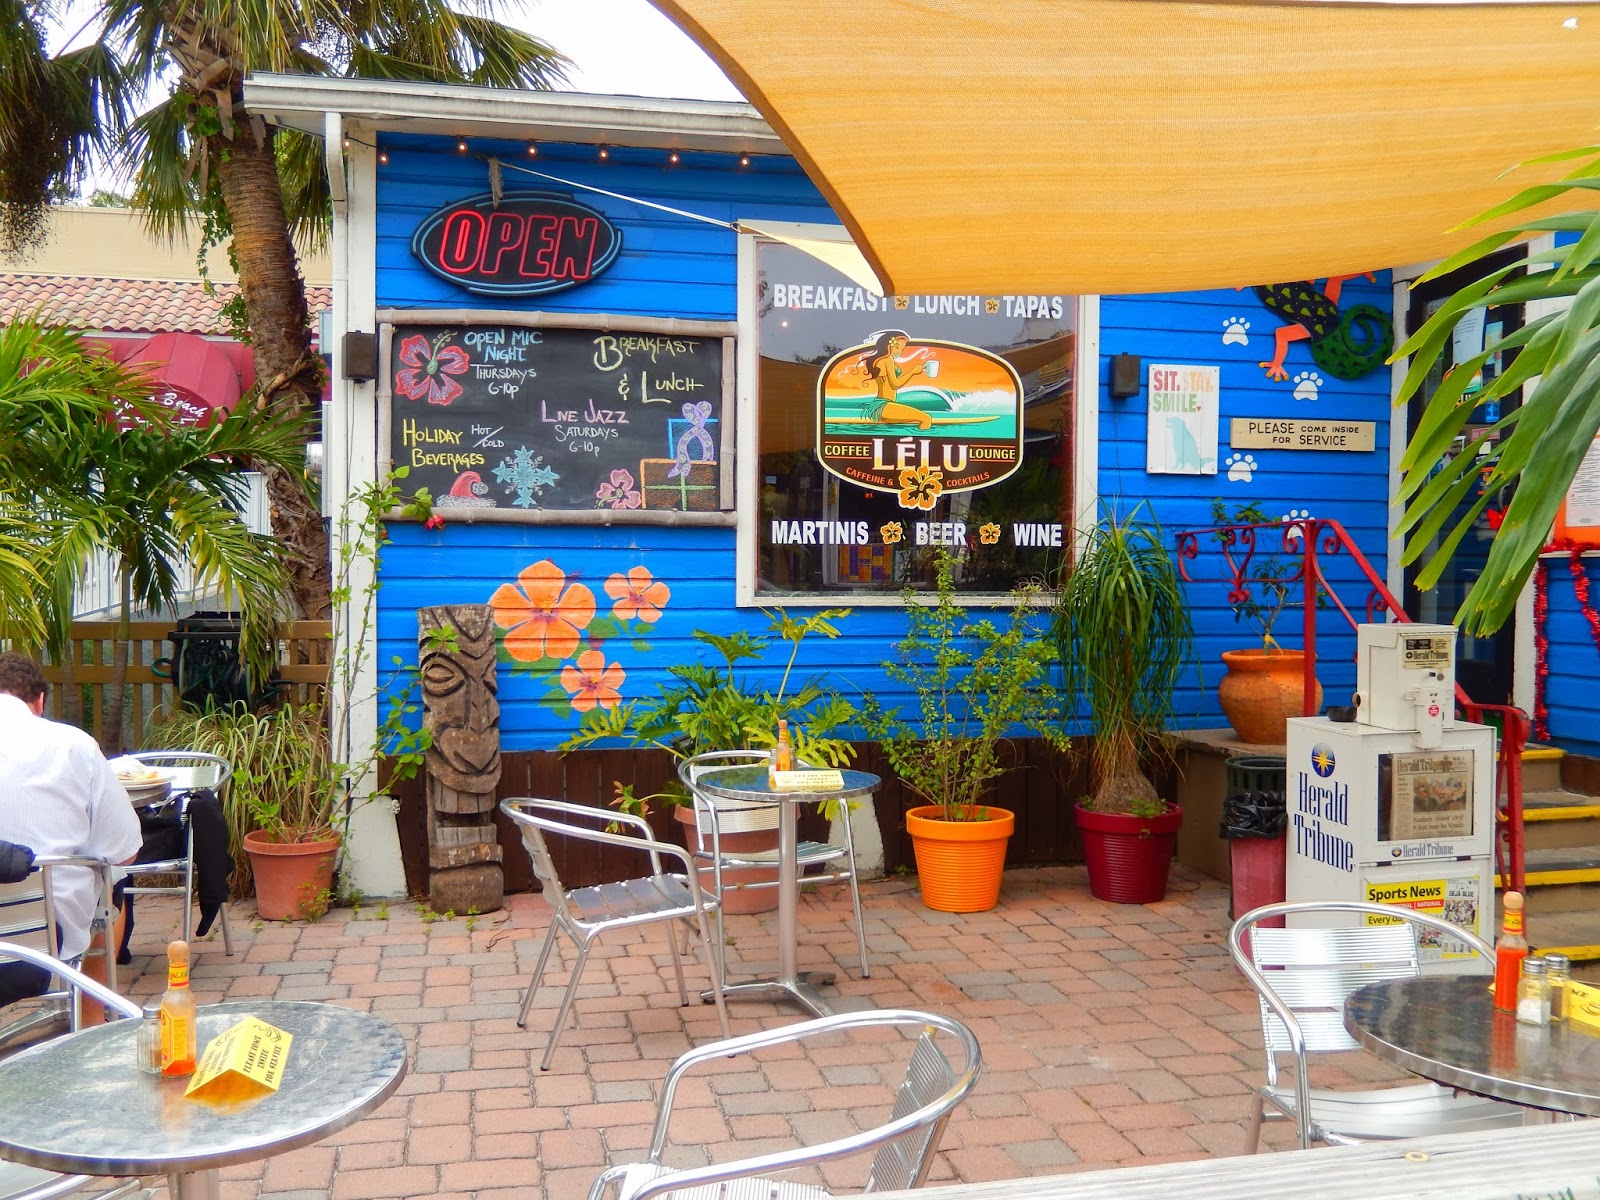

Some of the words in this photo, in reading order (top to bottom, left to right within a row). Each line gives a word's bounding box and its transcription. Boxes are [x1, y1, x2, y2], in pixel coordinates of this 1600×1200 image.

[439, 210, 599, 280] OPEN
[773, 283, 888, 312] BREAKFAST
[914, 294, 980, 316] LUNCH
[1003, 295, 1064, 319] TAPAS
[511, 330, 544, 346] MIC
[484, 345, 527, 364] NIGHT
[593, 336, 702, 371] BREAKFAST
[469, 363, 537, 384] THURSDAYS
[1153, 370, 1181, 392] SIT.
[617, 373, 630, 401] &
[641, 370, 704, 403] LUNCH
[163, 392, 208, 417] Beach
[584, 398, 629, 425] JAZZ
[403, 417, 464, 448] HOLIDAY
[555, 424, 619, 442] SATURDAYS
[1249, 422, 1296, 434] PLEASE
[1300, 425, 1327, 434] COME
[1332, 426, 1360, 434] INSIDE
[1272, 436, 1291, 444] FOR
[1299, 434, 1347, 446] SERVICE
[412, 448, 485, 473] BEVERAGES
[825, 444, 870, 457] COFFEE
[872, 436, 969, 472] LÉLU
[969, 447, 1016, 460] LOUNGE
[845, 466, 886, 486] CAFFEINE
[887, 478, 894, 486] &
[946, 471, 990, 487] COCKTAILS
[771, 520, 869, 545] MARTINIS
[915, 522, 968, 546] BEER
[1013, 523, 1063, 547] WINE
[1298, 771, 1348, 826] Herald
[1293, 813, 1354, 873] Tribune
[1403, 843, 1426, 858] Herald
[1427, 842, 1454, 856] Tribune
[1369, 888, 1407, 903] Sports
[1410, 886, 1441, 898] News
[1417, 900, 1442, 908] NATIONAL
[1368, 915, 1391, 925] Every
